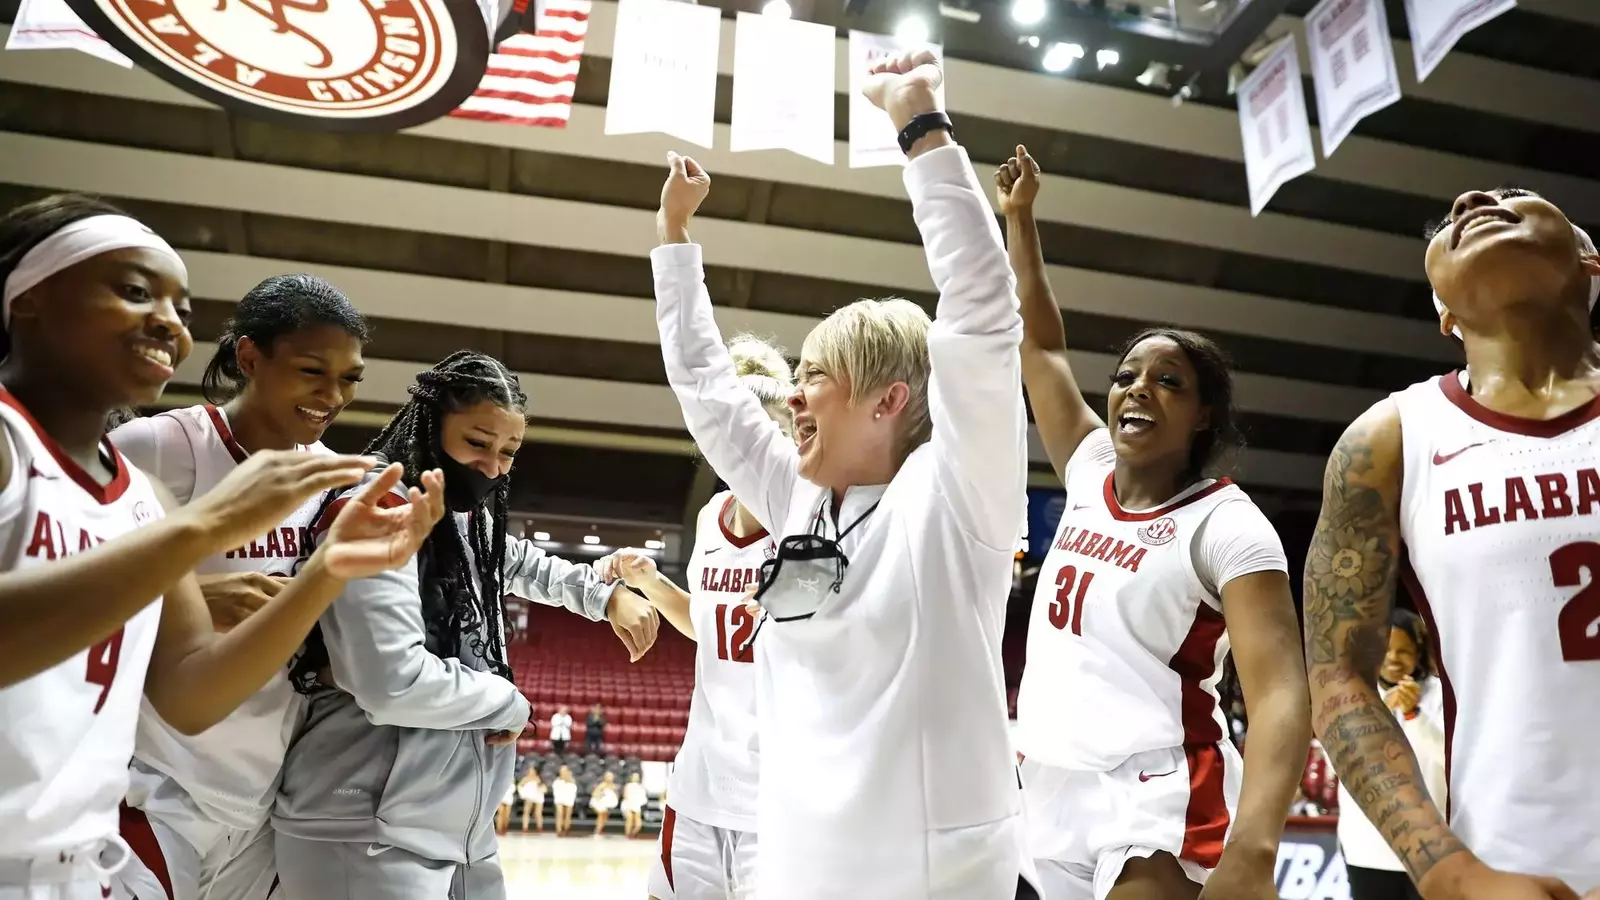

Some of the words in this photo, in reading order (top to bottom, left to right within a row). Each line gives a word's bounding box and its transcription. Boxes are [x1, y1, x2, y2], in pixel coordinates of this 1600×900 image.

[306, 14, 421, 101] CRIMSON
[1054, 526, 1148, 573] ALABAMA
[715, 603, 755, 663] 12
[1049, 565, 1095, 637] 31
[85, 623, 125, 716] 4
